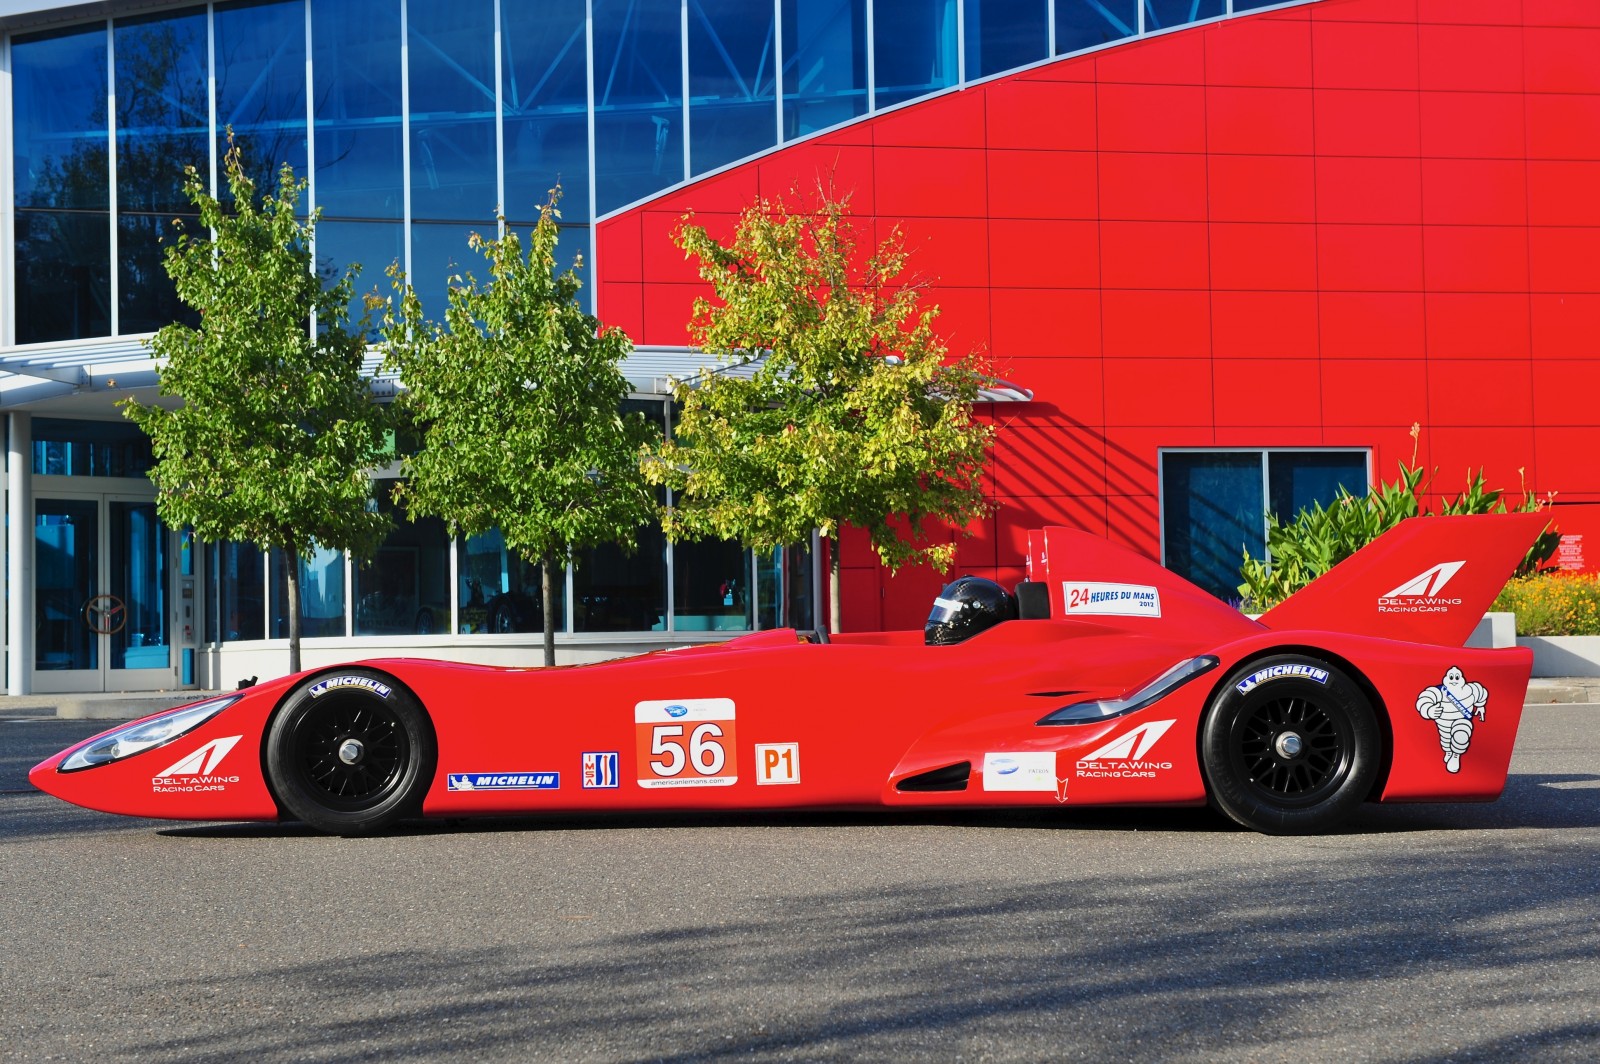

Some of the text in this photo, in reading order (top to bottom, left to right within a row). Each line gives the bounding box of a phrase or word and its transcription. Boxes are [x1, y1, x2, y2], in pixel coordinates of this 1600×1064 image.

[1070, 588, 1155, 608] 24 HEURES DU MANS
[1254, 665, 1327, 682] MICHELIN
[326, 677, 389, 694] MICHELIN
[649, 722, 726, 778] 56
[765, 748, 793, 779] P1
[1076, 761, 1173, 769] DELTAWING
[152, 776, 240, 785] DELTAWING
[476, 775, 555, 786] MICHELIN
